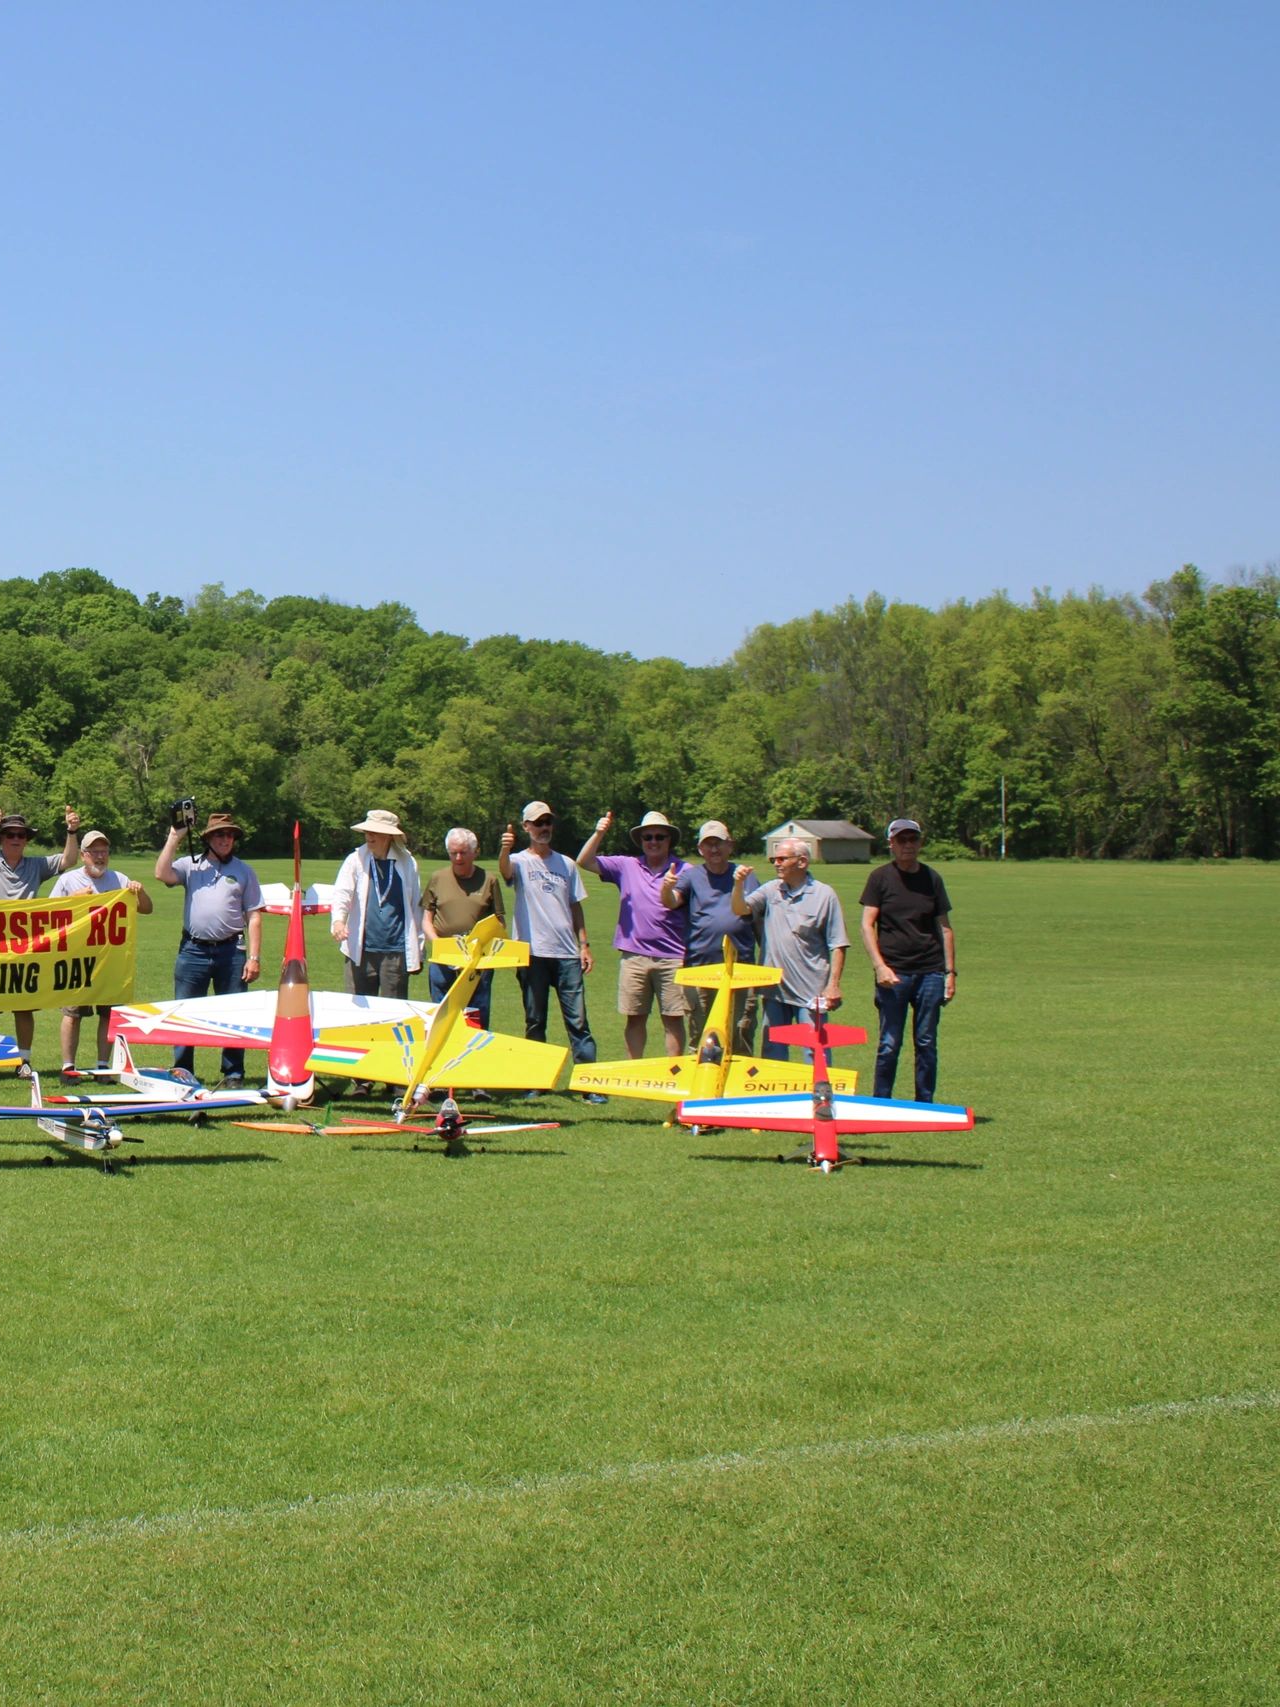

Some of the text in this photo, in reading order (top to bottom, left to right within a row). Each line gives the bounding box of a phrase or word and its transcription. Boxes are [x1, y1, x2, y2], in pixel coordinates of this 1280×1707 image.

[86, 901, 128, 946] RC
[53, 956, 97, 992] DAY
[579, 1075, 677, 1089] BREITLING
[744, 1082, 847, 1092] BITLING
